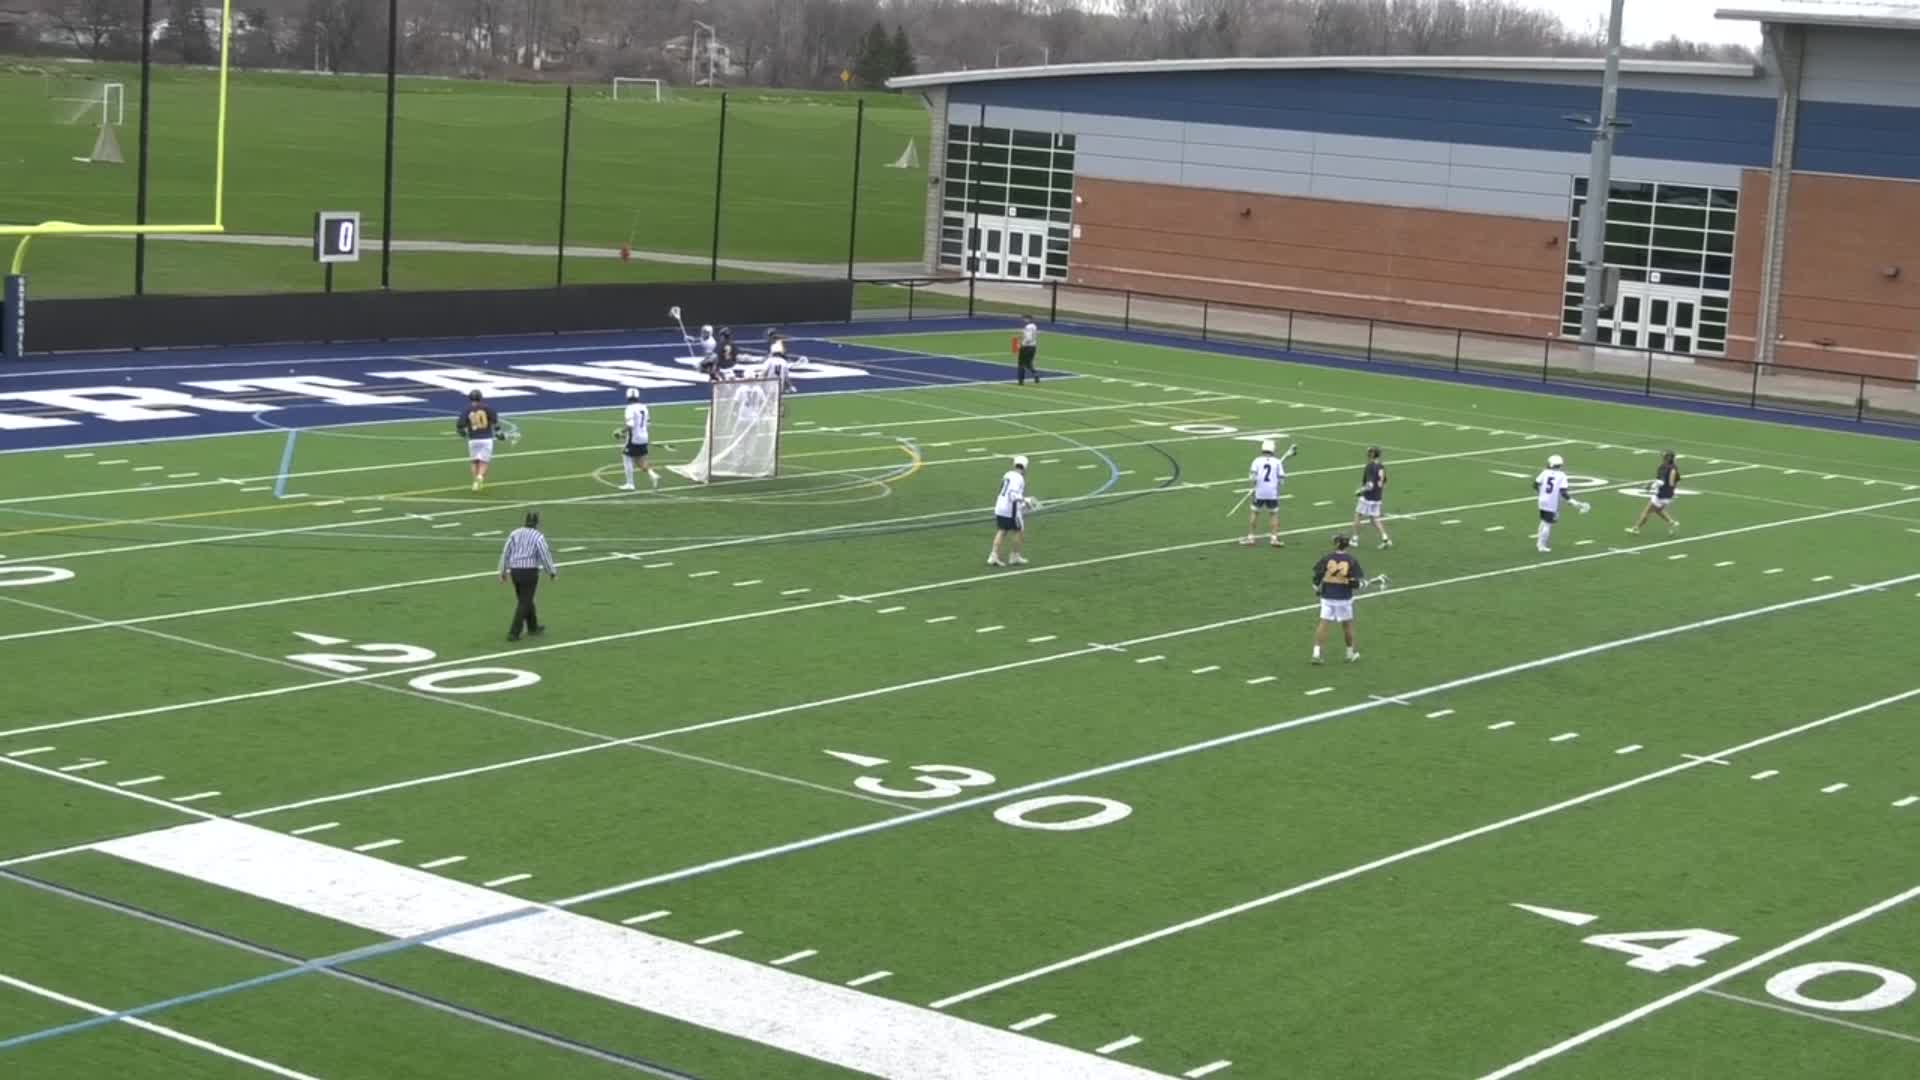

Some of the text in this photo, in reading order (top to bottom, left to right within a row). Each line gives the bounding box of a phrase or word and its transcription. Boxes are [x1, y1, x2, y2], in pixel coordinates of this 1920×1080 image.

[338, 221, 353, 252] 0
[1263, 463, 1271, 482] 2
[1545, 476, 1555, 494] 5
[285, 643, 542, 693] 20
[853, 764, 1133, 831] 30
[1581, 928, 1917, 1011] 40
